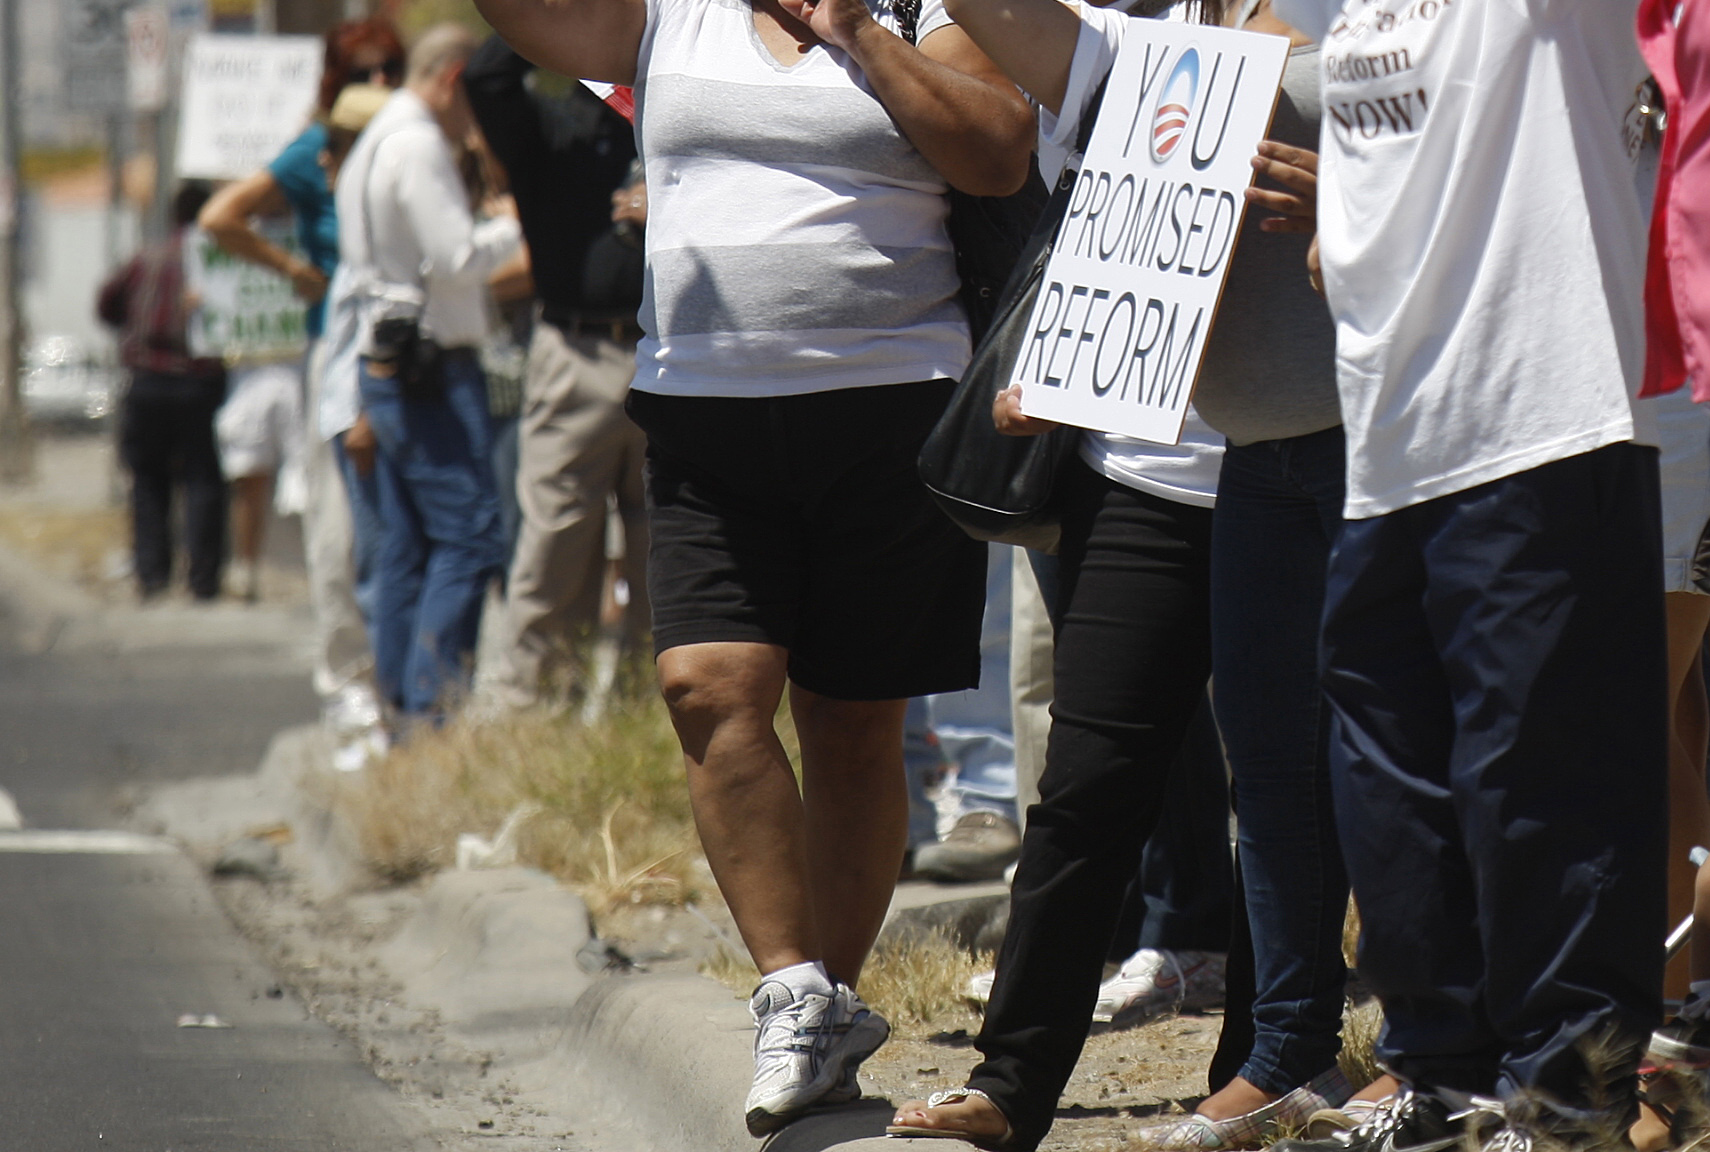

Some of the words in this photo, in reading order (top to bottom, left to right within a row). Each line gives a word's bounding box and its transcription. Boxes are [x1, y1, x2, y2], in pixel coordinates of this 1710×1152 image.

[1121, 39, 1247, 172] YOU
[1328, 88, 1429, 140] NOW!
[1056, 168, 1236, 279] PROMISED
[1019, 280, 1205, 412] REFORM
